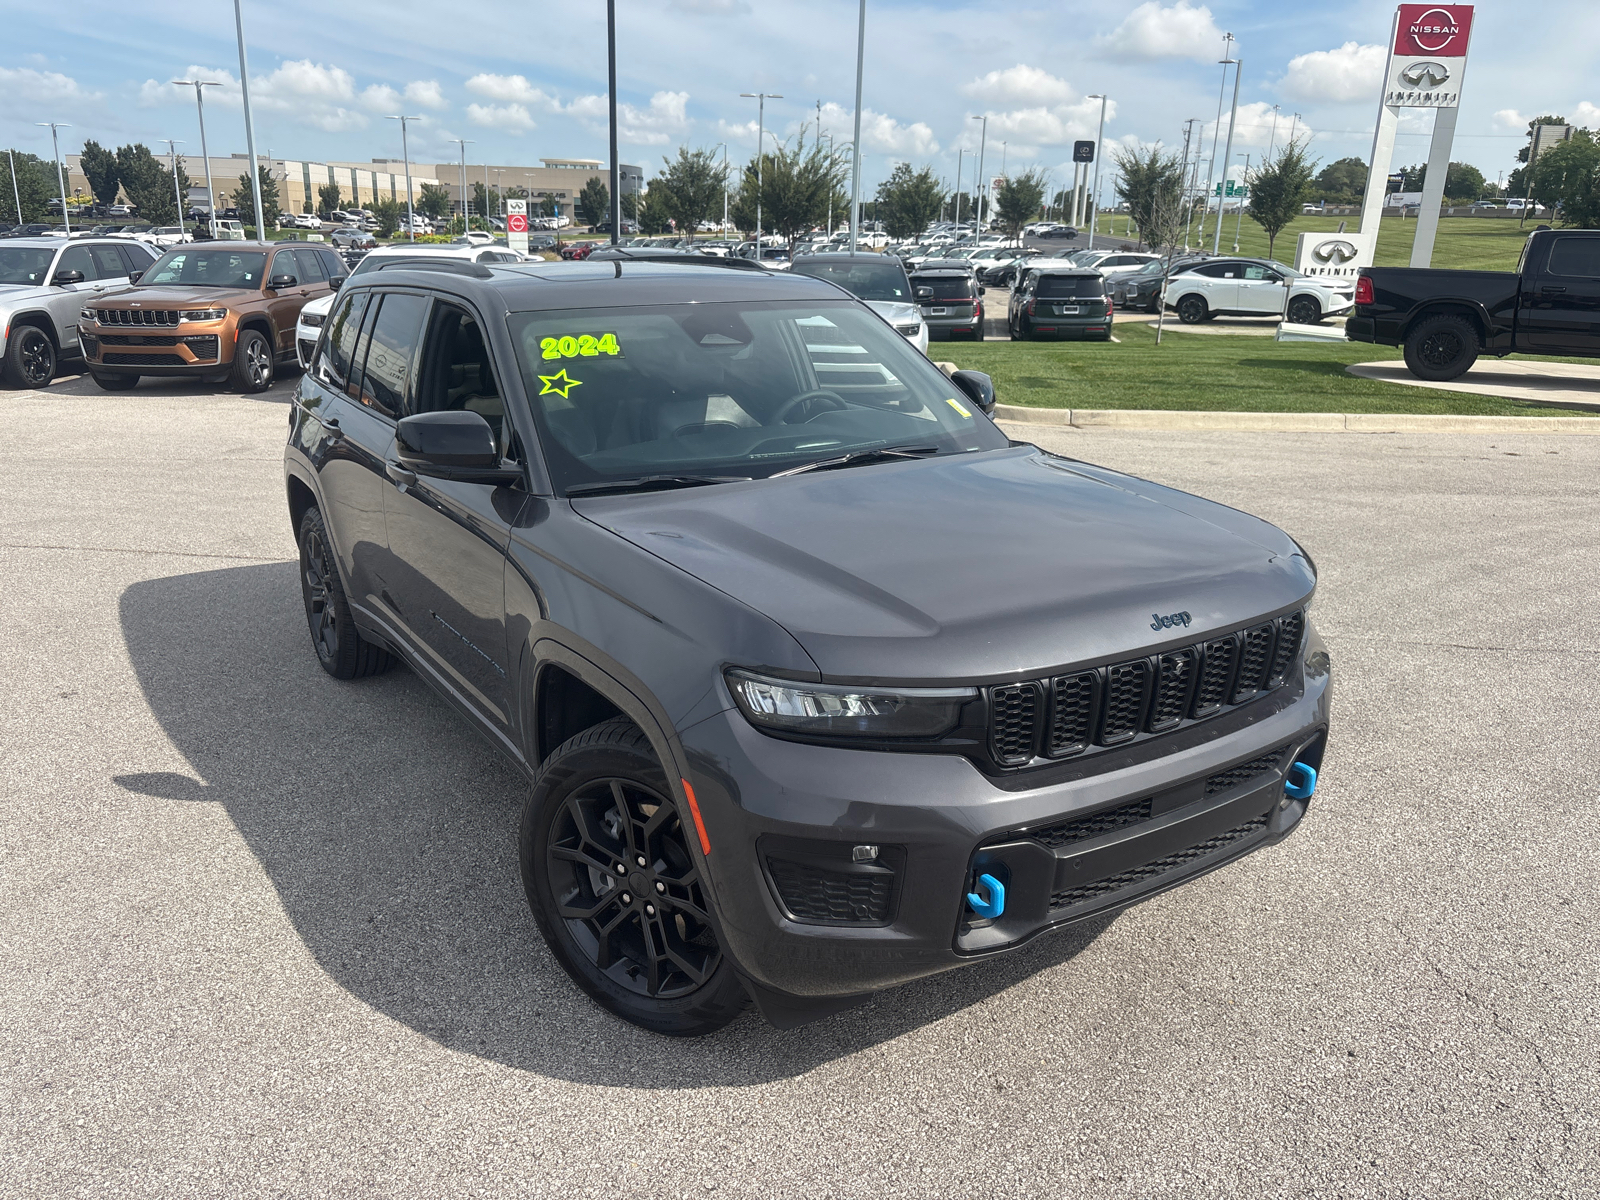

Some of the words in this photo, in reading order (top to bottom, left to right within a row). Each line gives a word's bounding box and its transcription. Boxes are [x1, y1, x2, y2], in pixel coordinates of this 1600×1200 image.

[1410, 25, 1459, 34] NISSAN
[1389, 91, 1457, 102] INFINITI
[531, 191, 567, 199] LEUS
[1303, 267, 1356, 277] INFINIT
[540, 333, 620, 360] 2024
[1150, 611, 1192, 631] Jeep
